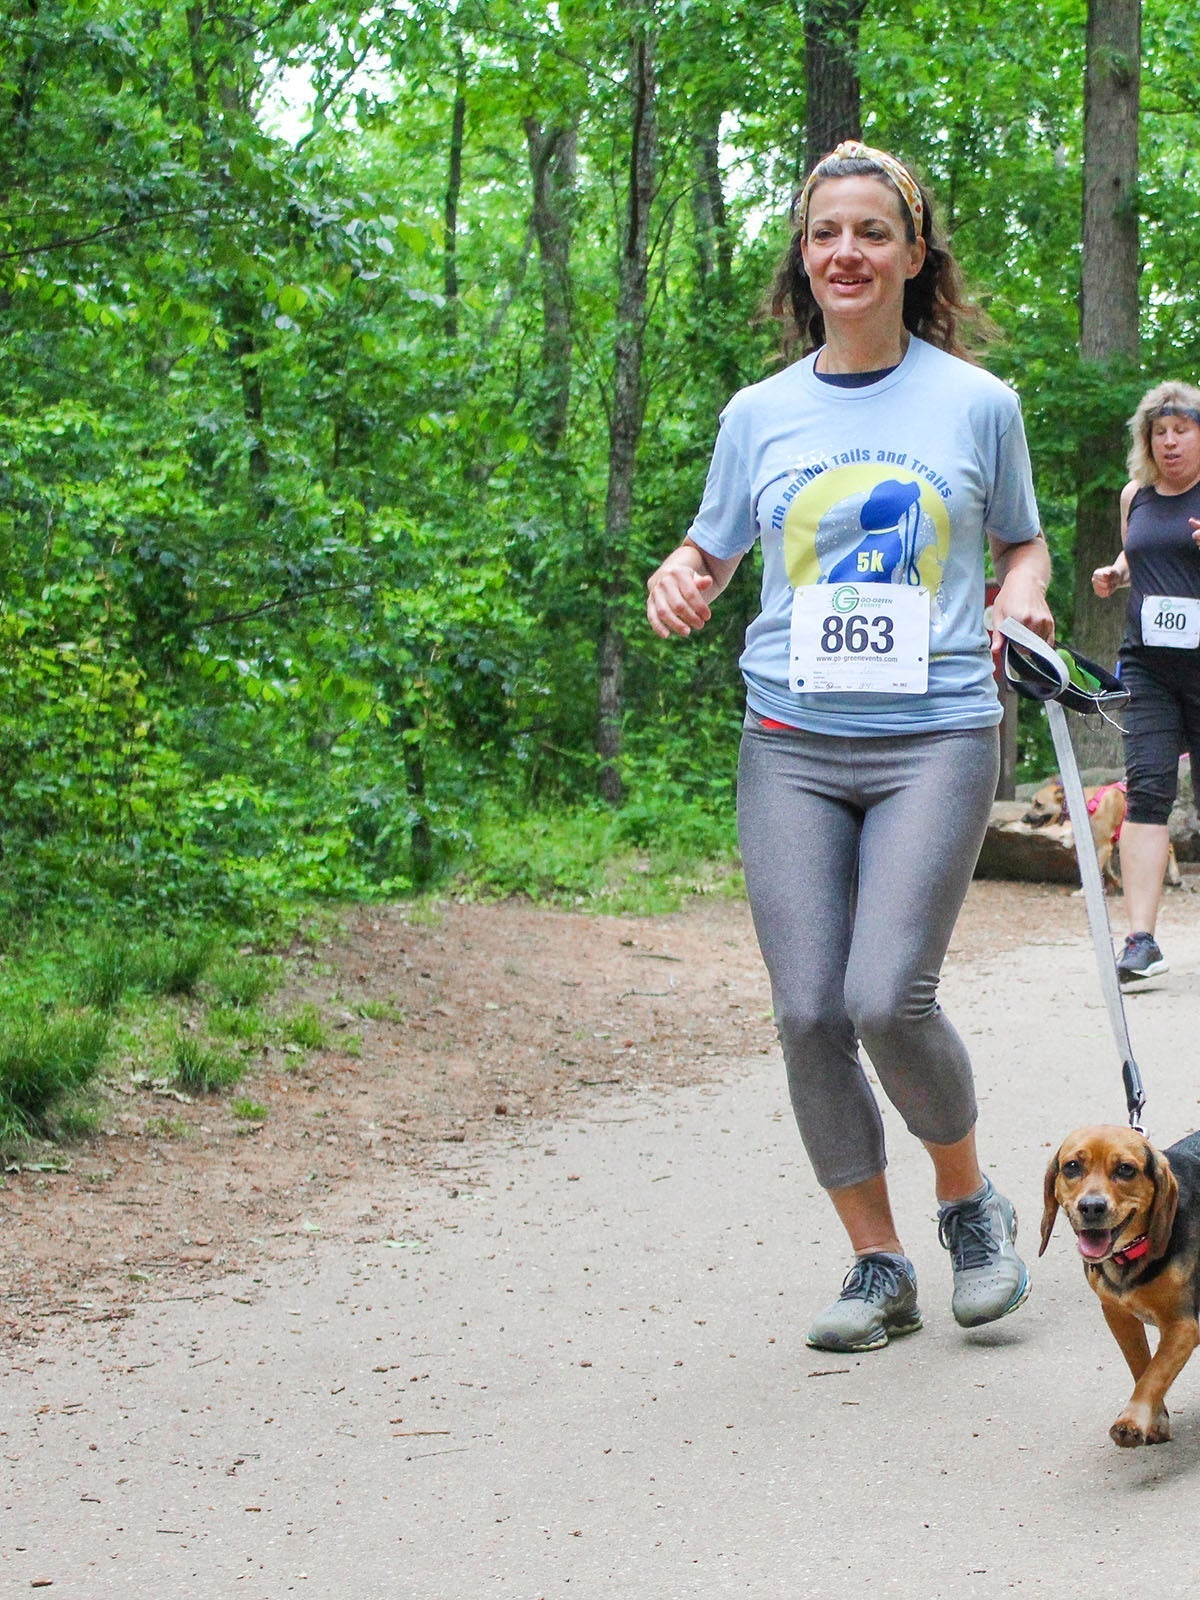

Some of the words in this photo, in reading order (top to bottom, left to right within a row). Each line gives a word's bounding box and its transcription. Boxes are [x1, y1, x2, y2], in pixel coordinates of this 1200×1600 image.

[771, 505, 786, 530] 7th
[832, 449, 870, 466] Tails
[876, 450, 907, 466] and
[911, 459, 952, 499] Trails
[820, 615, 894, 654] 863
[1154, 612, 1187, 631] 480
[816, 655, 898, 663] www.go-greenevents.com
